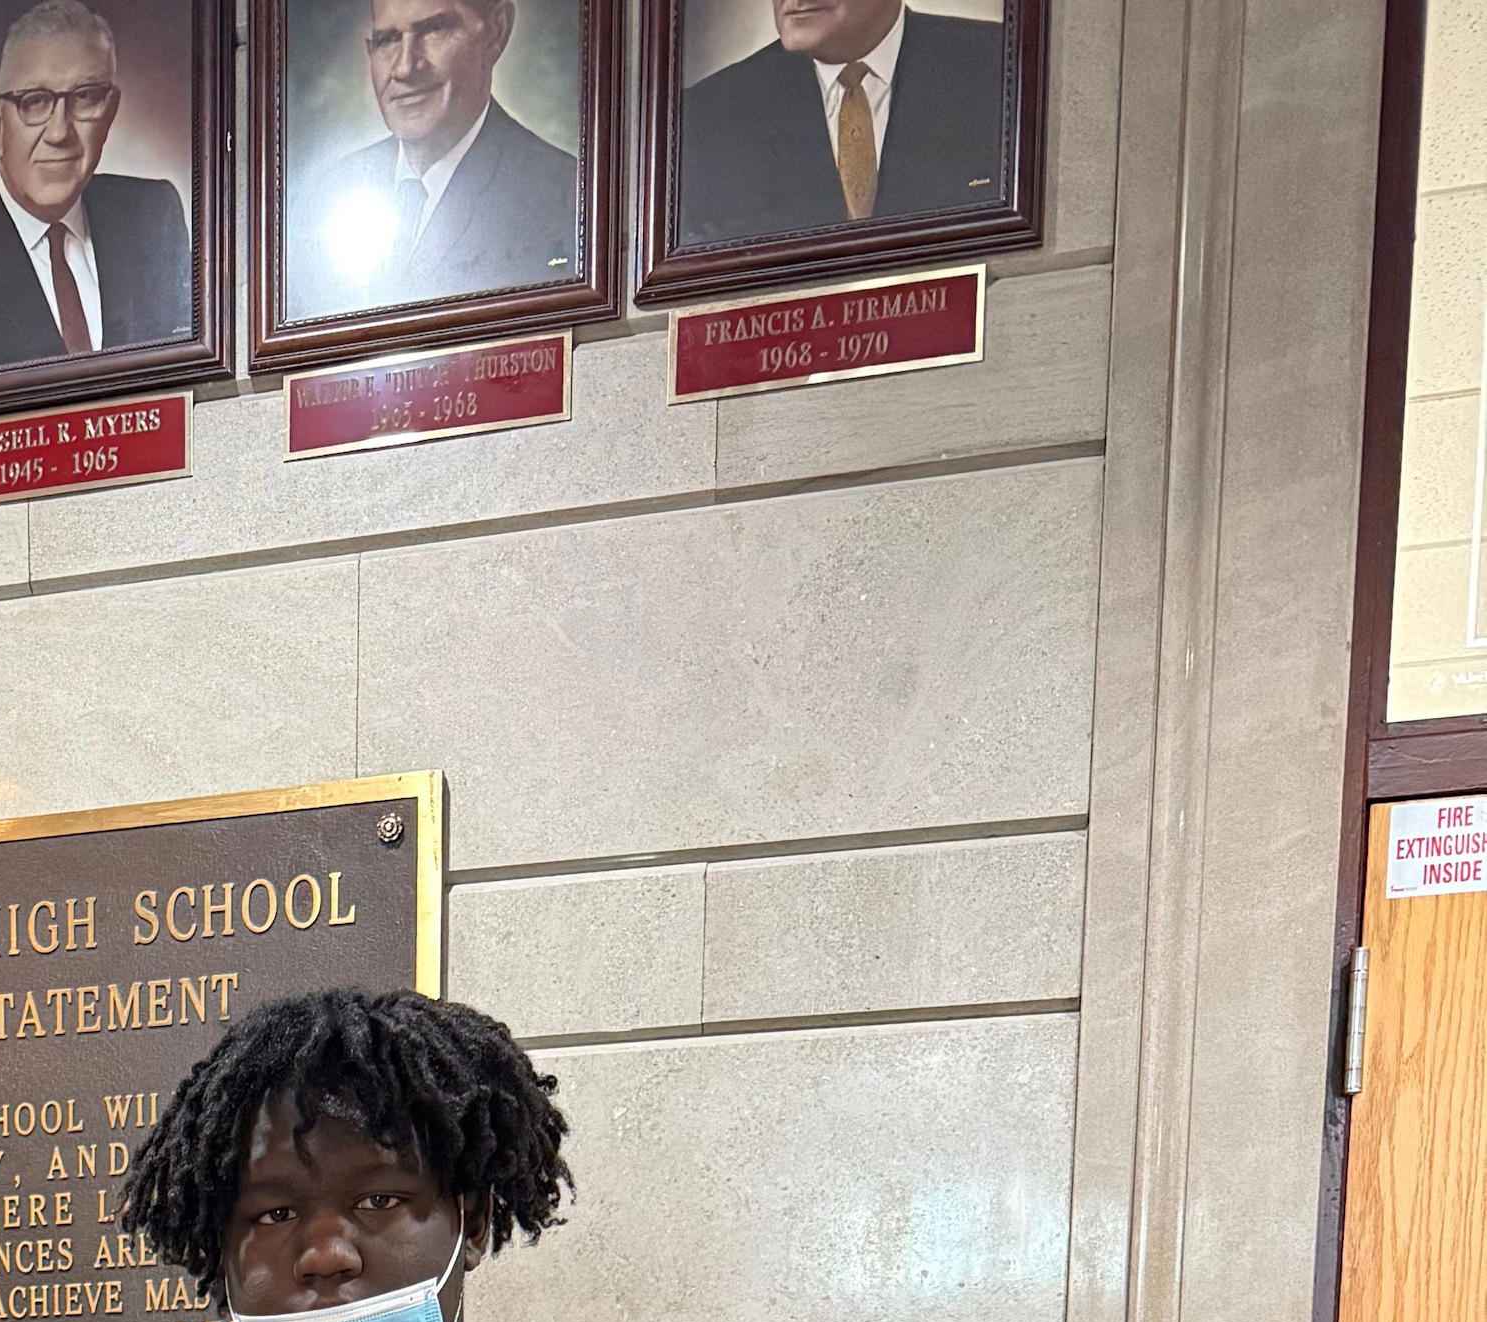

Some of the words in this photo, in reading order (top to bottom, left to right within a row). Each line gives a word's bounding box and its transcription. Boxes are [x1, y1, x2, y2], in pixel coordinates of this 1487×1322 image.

[705, 307, 805, 346] FRANCIS
[811, 305, 834, 330] A.
[843, 286, 948, 326] FIRMANI
[760, 342, 812, 373] 1968
[837, 331, 889, 362] 1970
[433, 392, 478, 422] 1968
[57, 422, 77, 444] R.
[84, 408, 161, 440] MYERS
[0, 457, 44, 486] 1945
[72, 446, 119, 476] 1965
[1437, 806, 1474, 829] FIRE
[1423, 860, 1482, 885] INSIDE
[132, 872, 358, 947] SCHOOL
[46, 1143, 129, 1181] AND
[94, 1233, 157, 1269] ARE
